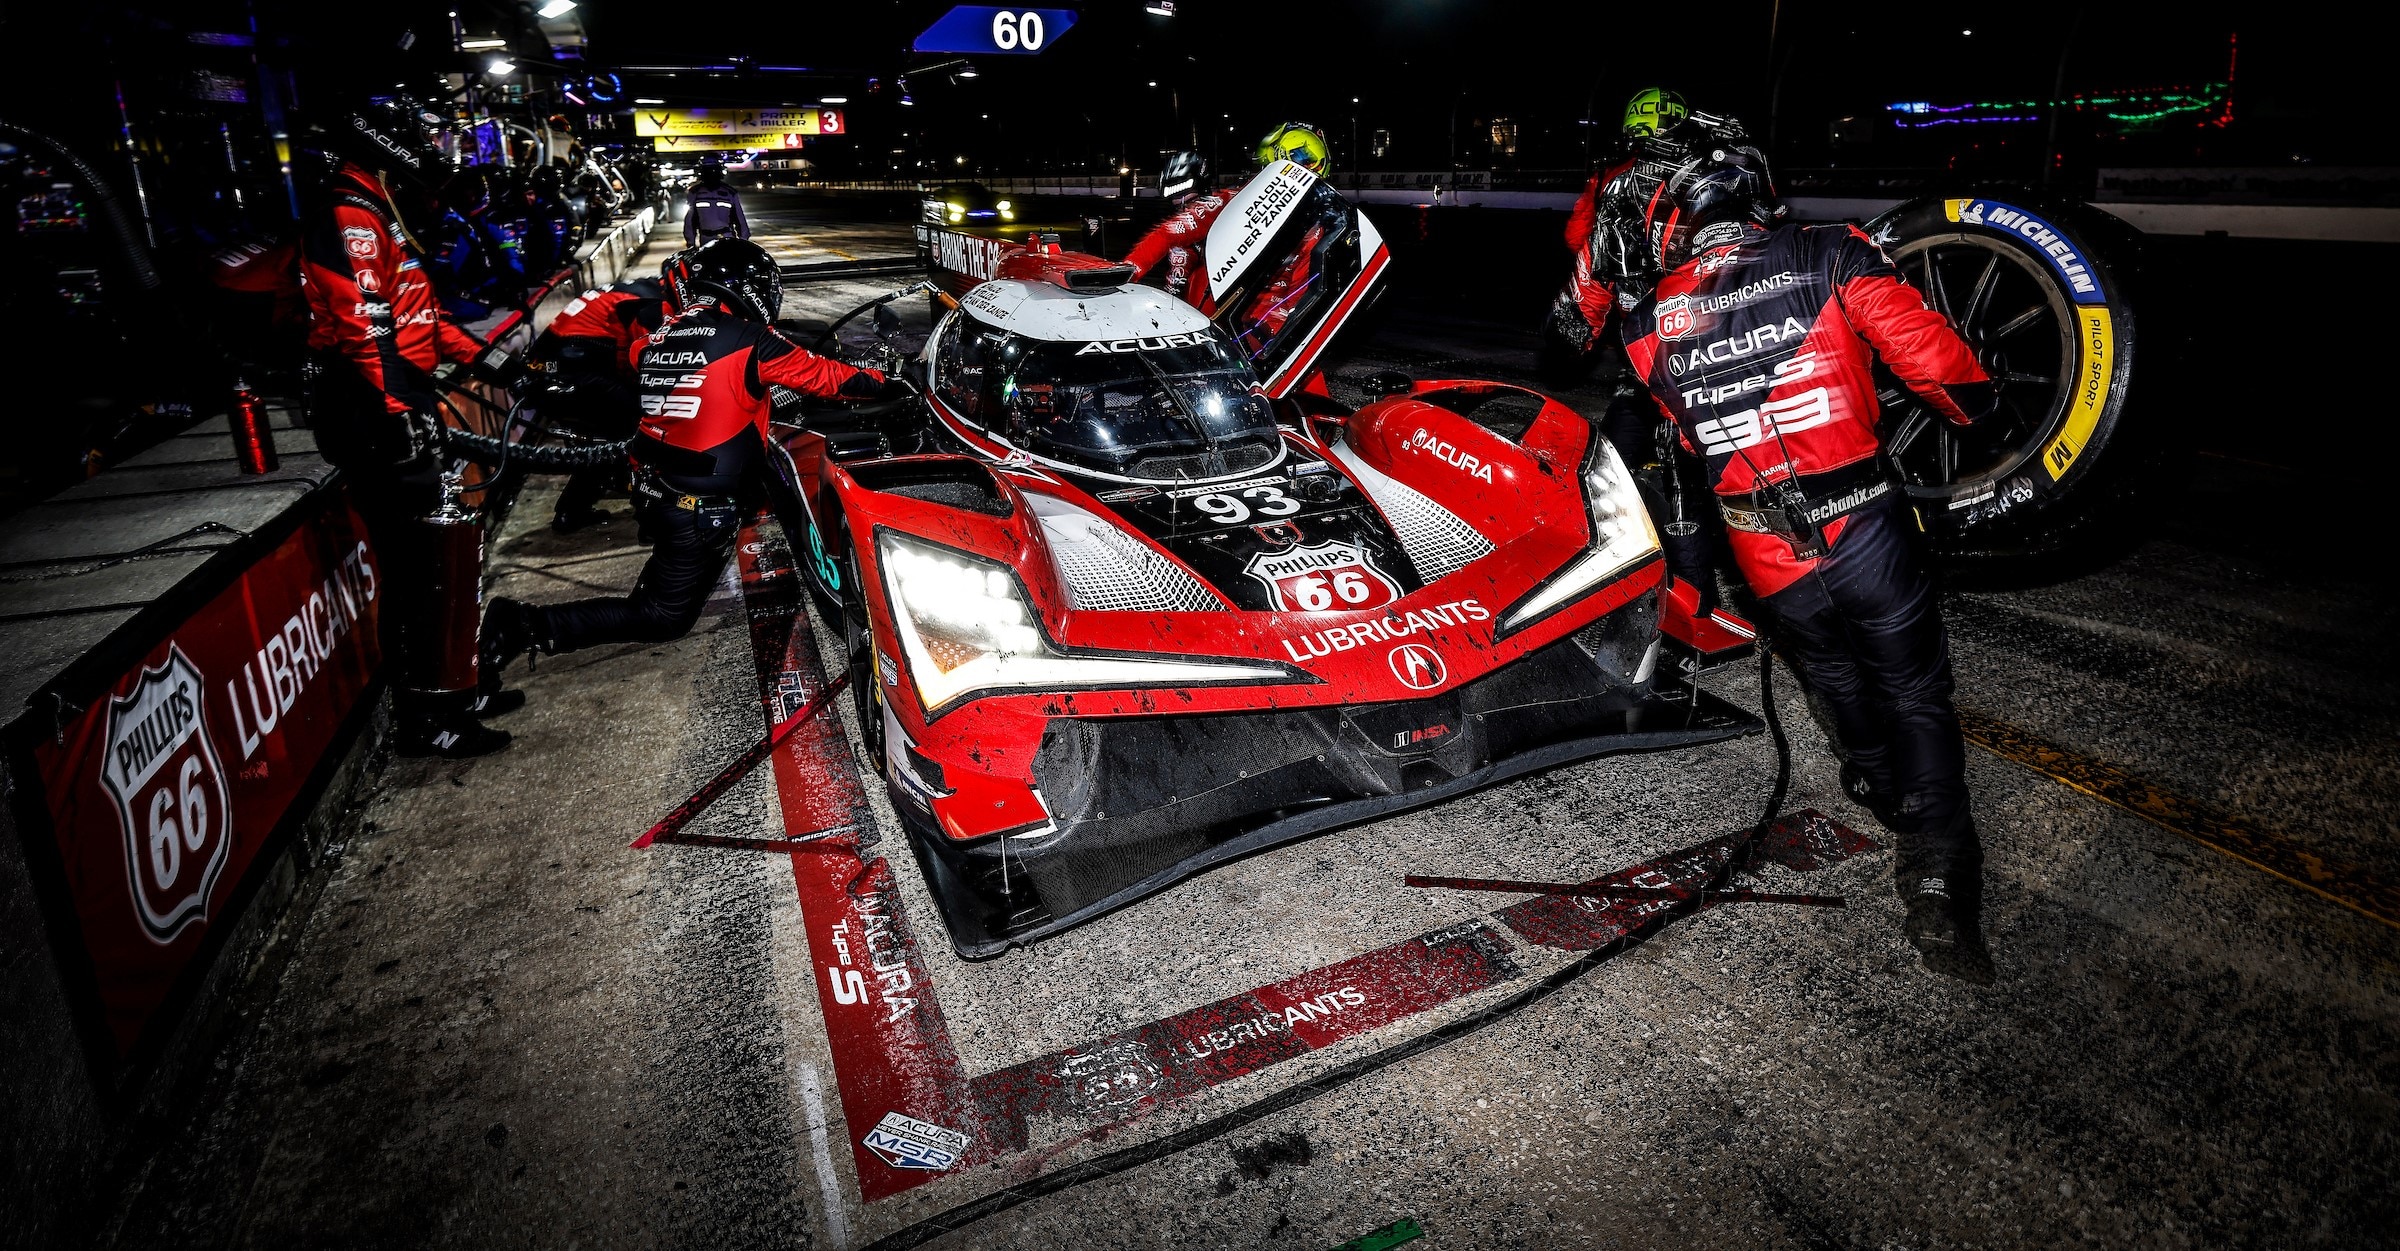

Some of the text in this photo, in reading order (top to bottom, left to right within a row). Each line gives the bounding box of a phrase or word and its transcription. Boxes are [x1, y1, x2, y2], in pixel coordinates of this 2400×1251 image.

[992, 11, 1045, 51] 60
[760, 119, 807, 127] MILLER
[823, 111, 840, 132] 3
[1627, 101, 1689, 120] ACUR
[364, 128, 421, 169] ACURA
[786, 134, 799, 147] 4
[753, 159, 780, 170] Mobil
[1243, 180, 1290, 230] YELLOLY
[1244, 176, 1282, 218] PALOU
[351, 240, 372, 253] 66
[1212, 185, 1300, 283] VAN DER ZANDE
[1651, 221, 1664, 265] ACURA
[1987, 207, 2096, 294] MICHELIN
[940, 231, 967, 275] BRING
[966, 236, 987, 281] THE
[354, 302, 391, 317] HRC
[678, 281, 690, 310] ACUR
[748, 293, 772, 324] ACURA
[1657, 298, 1687, 316] PHILLIPS
[1700, 271, 1794, 315] LUBRICANTS
[1663, 311, 1687, 334] 66
[649, 351, 709, 366] ACURA
[1074, 331, 1219, 357] ACURA
[1688, 316, 1808, 372] ACURA
[639, 373, 708, 389] Type S
[1681, 350, 1818, 410] Type S
[2087, 318, 2103, 411] PILOT SPORT
[1694, 386, 1832, 457] 93
[1421, 436, 1493, 485] ACURA
[2049, 440, 2073, 471] M
[1168, 476, 1284, 499] WeatherTech
[1194, 486, 1302, 524] 93
[1263, 550, 1356, 578] PHILLIPS
[1295, 571, 1370, 612] 66
[226, 540, 377, 761] LUBRICANTS
[1281, 598, 1491, 663] LUBRICANTS
[116, 679, 196, 790] PHILLIPS
[148, 754, 207, 890] 66
[828, 918, 870, 1005] Type S
[1171, 986, 1366, 1065] LUBRICANTS
[867, 1131, 953, 1167] MSR
[875, 1124, 903, 1138] MEYER
[902, 1132, 929, 1146] SHANK
